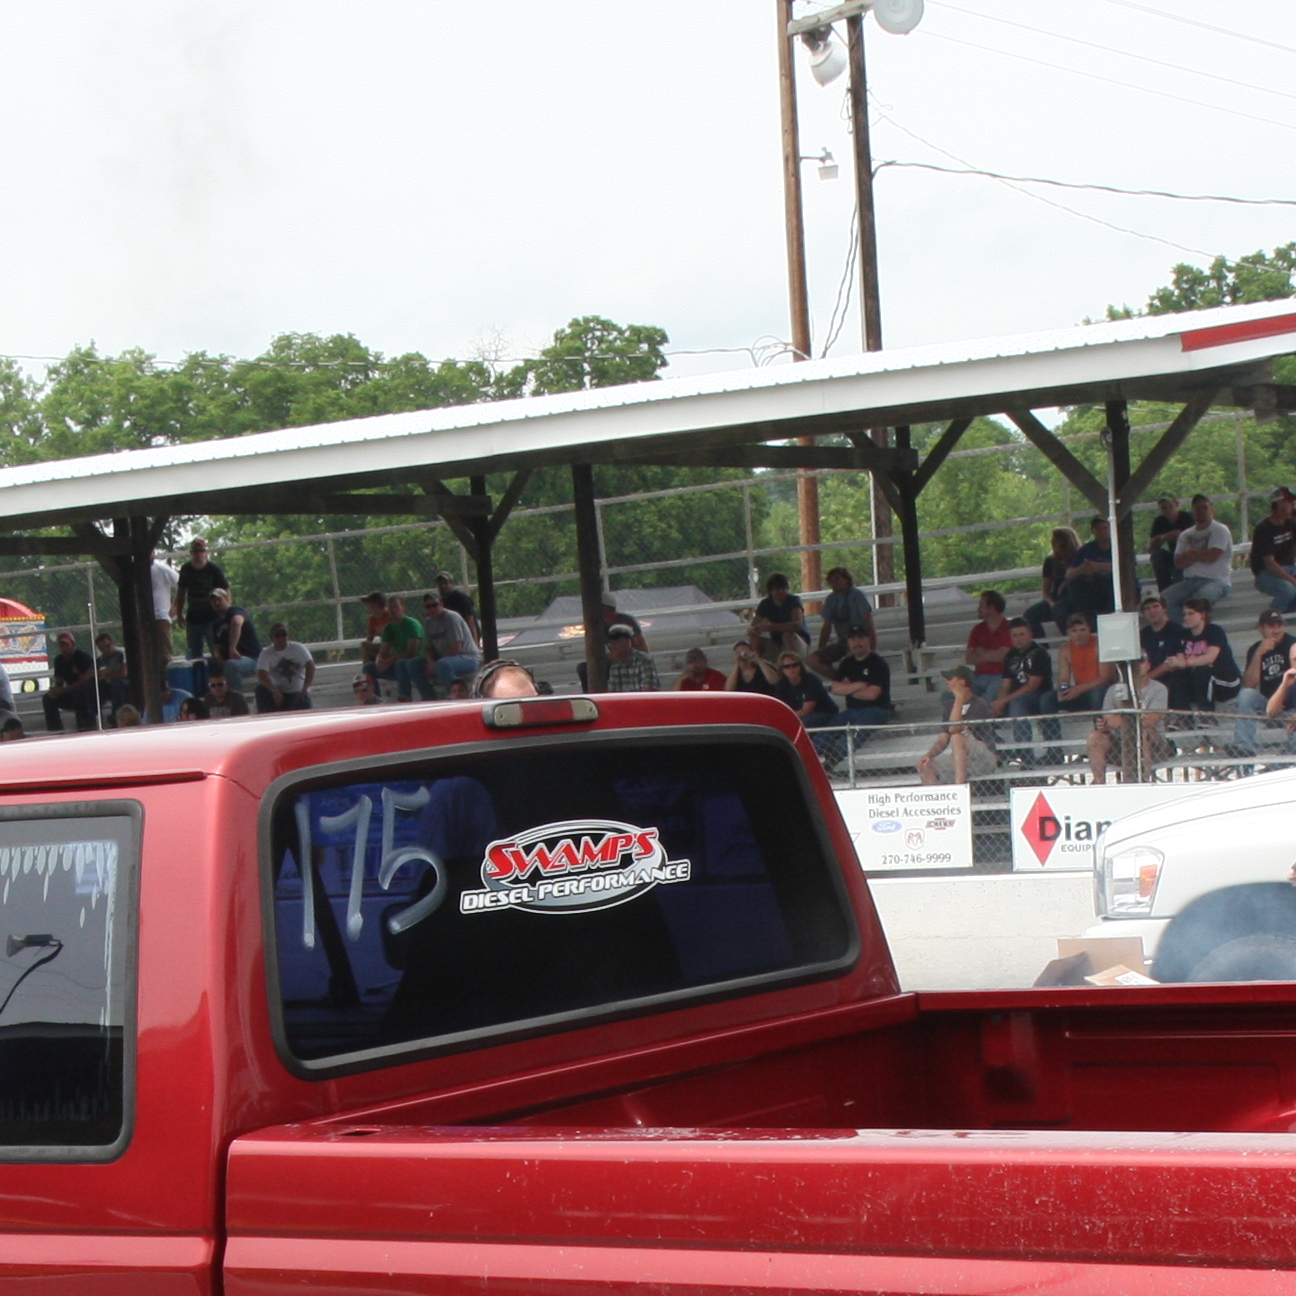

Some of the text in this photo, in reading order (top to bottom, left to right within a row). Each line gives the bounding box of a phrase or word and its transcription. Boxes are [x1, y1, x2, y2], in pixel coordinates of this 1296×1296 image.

[868, 791, 959, 806] High Performance
[868, 805, 962, 819] Diesel Accessories
[881, 853, 952, 865] 270-746-9999
[295, 785, 447, 950] 175
[462, 862, 689, 911] DIESEL PERFORMANCE
